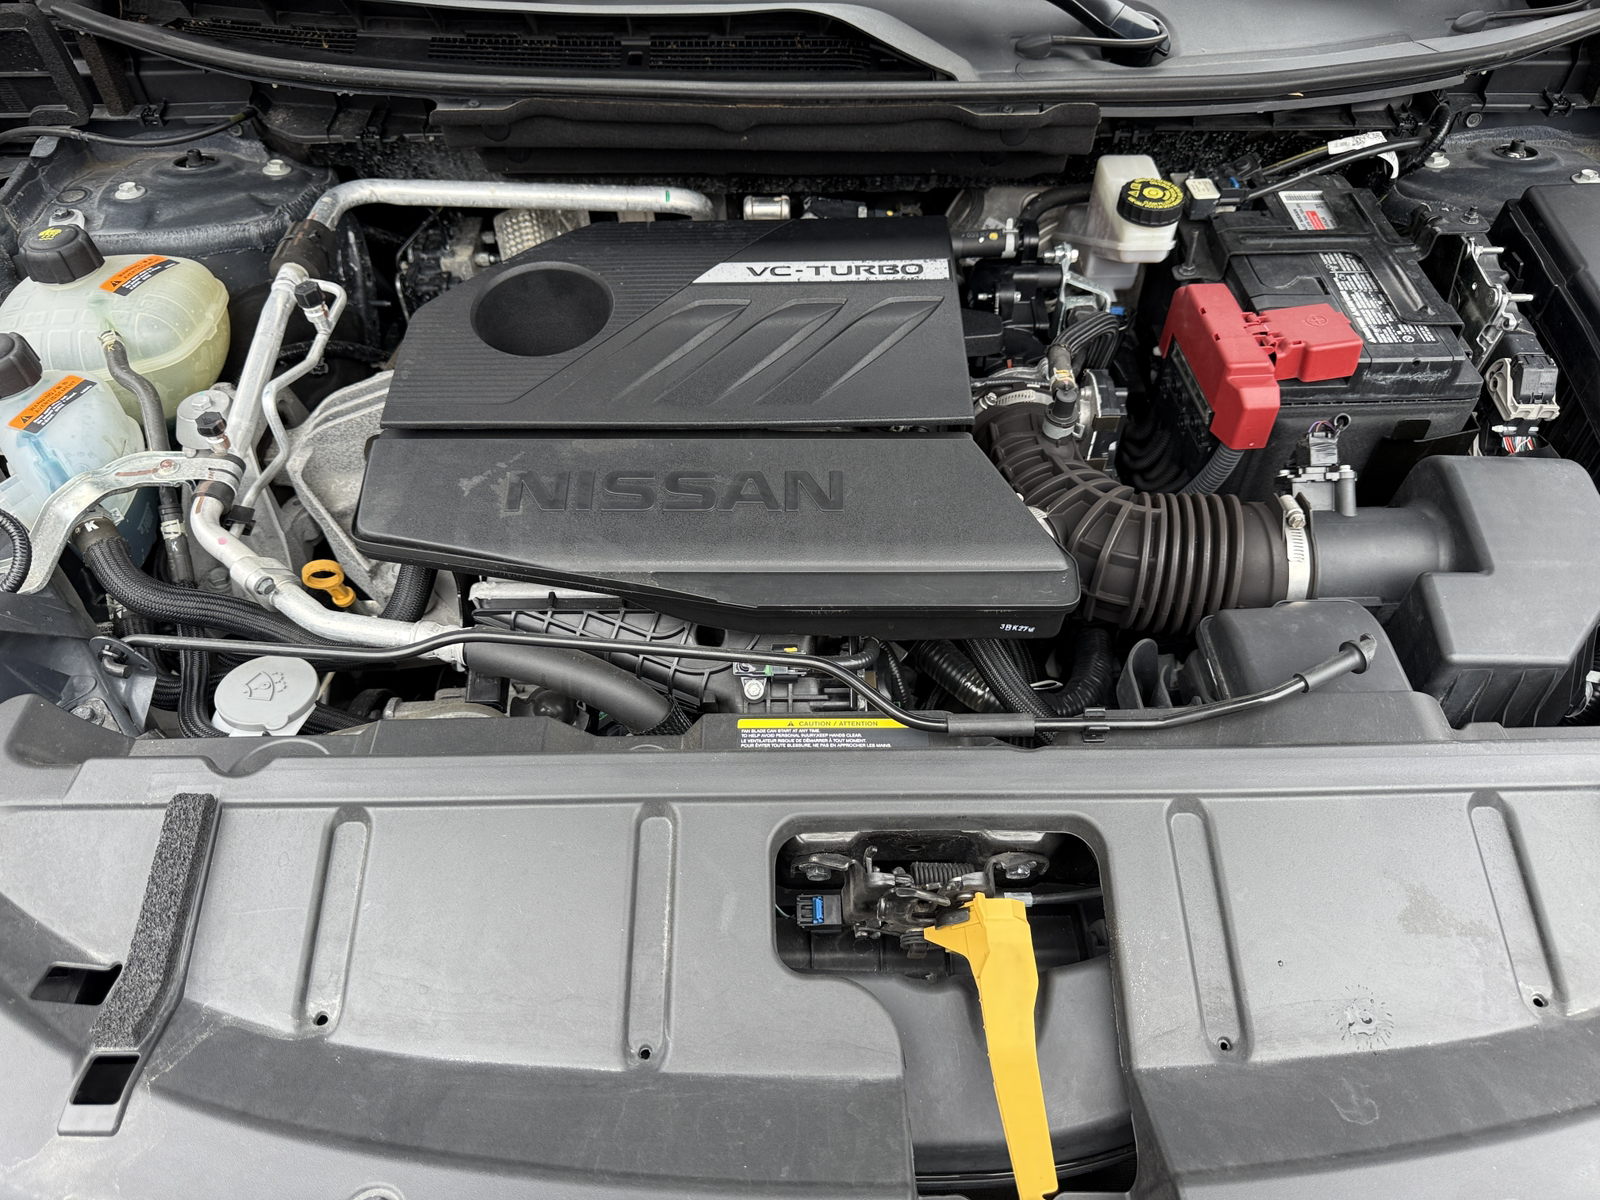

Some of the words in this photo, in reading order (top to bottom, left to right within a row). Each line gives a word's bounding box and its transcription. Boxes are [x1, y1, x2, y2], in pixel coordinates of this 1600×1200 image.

[746, 263, 924, 277] VC-TURBO
[504, 470, 844, 512] NISSAN
[84, 520, 100, 533] K
[170, 541, 179, 552] K
